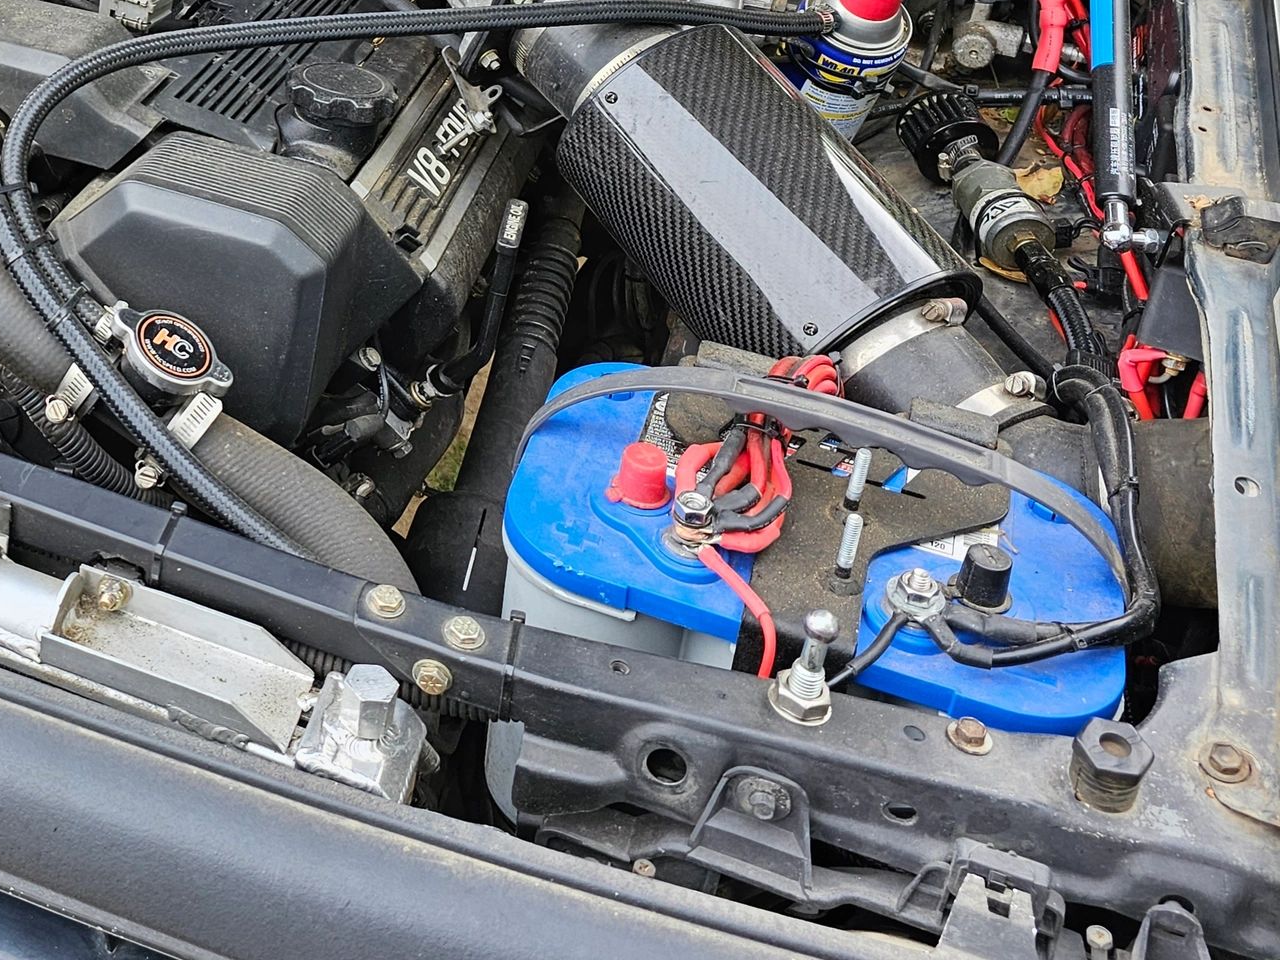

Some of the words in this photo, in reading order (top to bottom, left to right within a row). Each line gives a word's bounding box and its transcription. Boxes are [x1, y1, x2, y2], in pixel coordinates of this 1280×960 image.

[820, 57, 856, 76] WD-40
[406, 146, 451, 197] V8
[510, 204, 523, 216] OIL
[503, 213, 521, 241] ENGINE
[153, 327, 194, 360] HC
